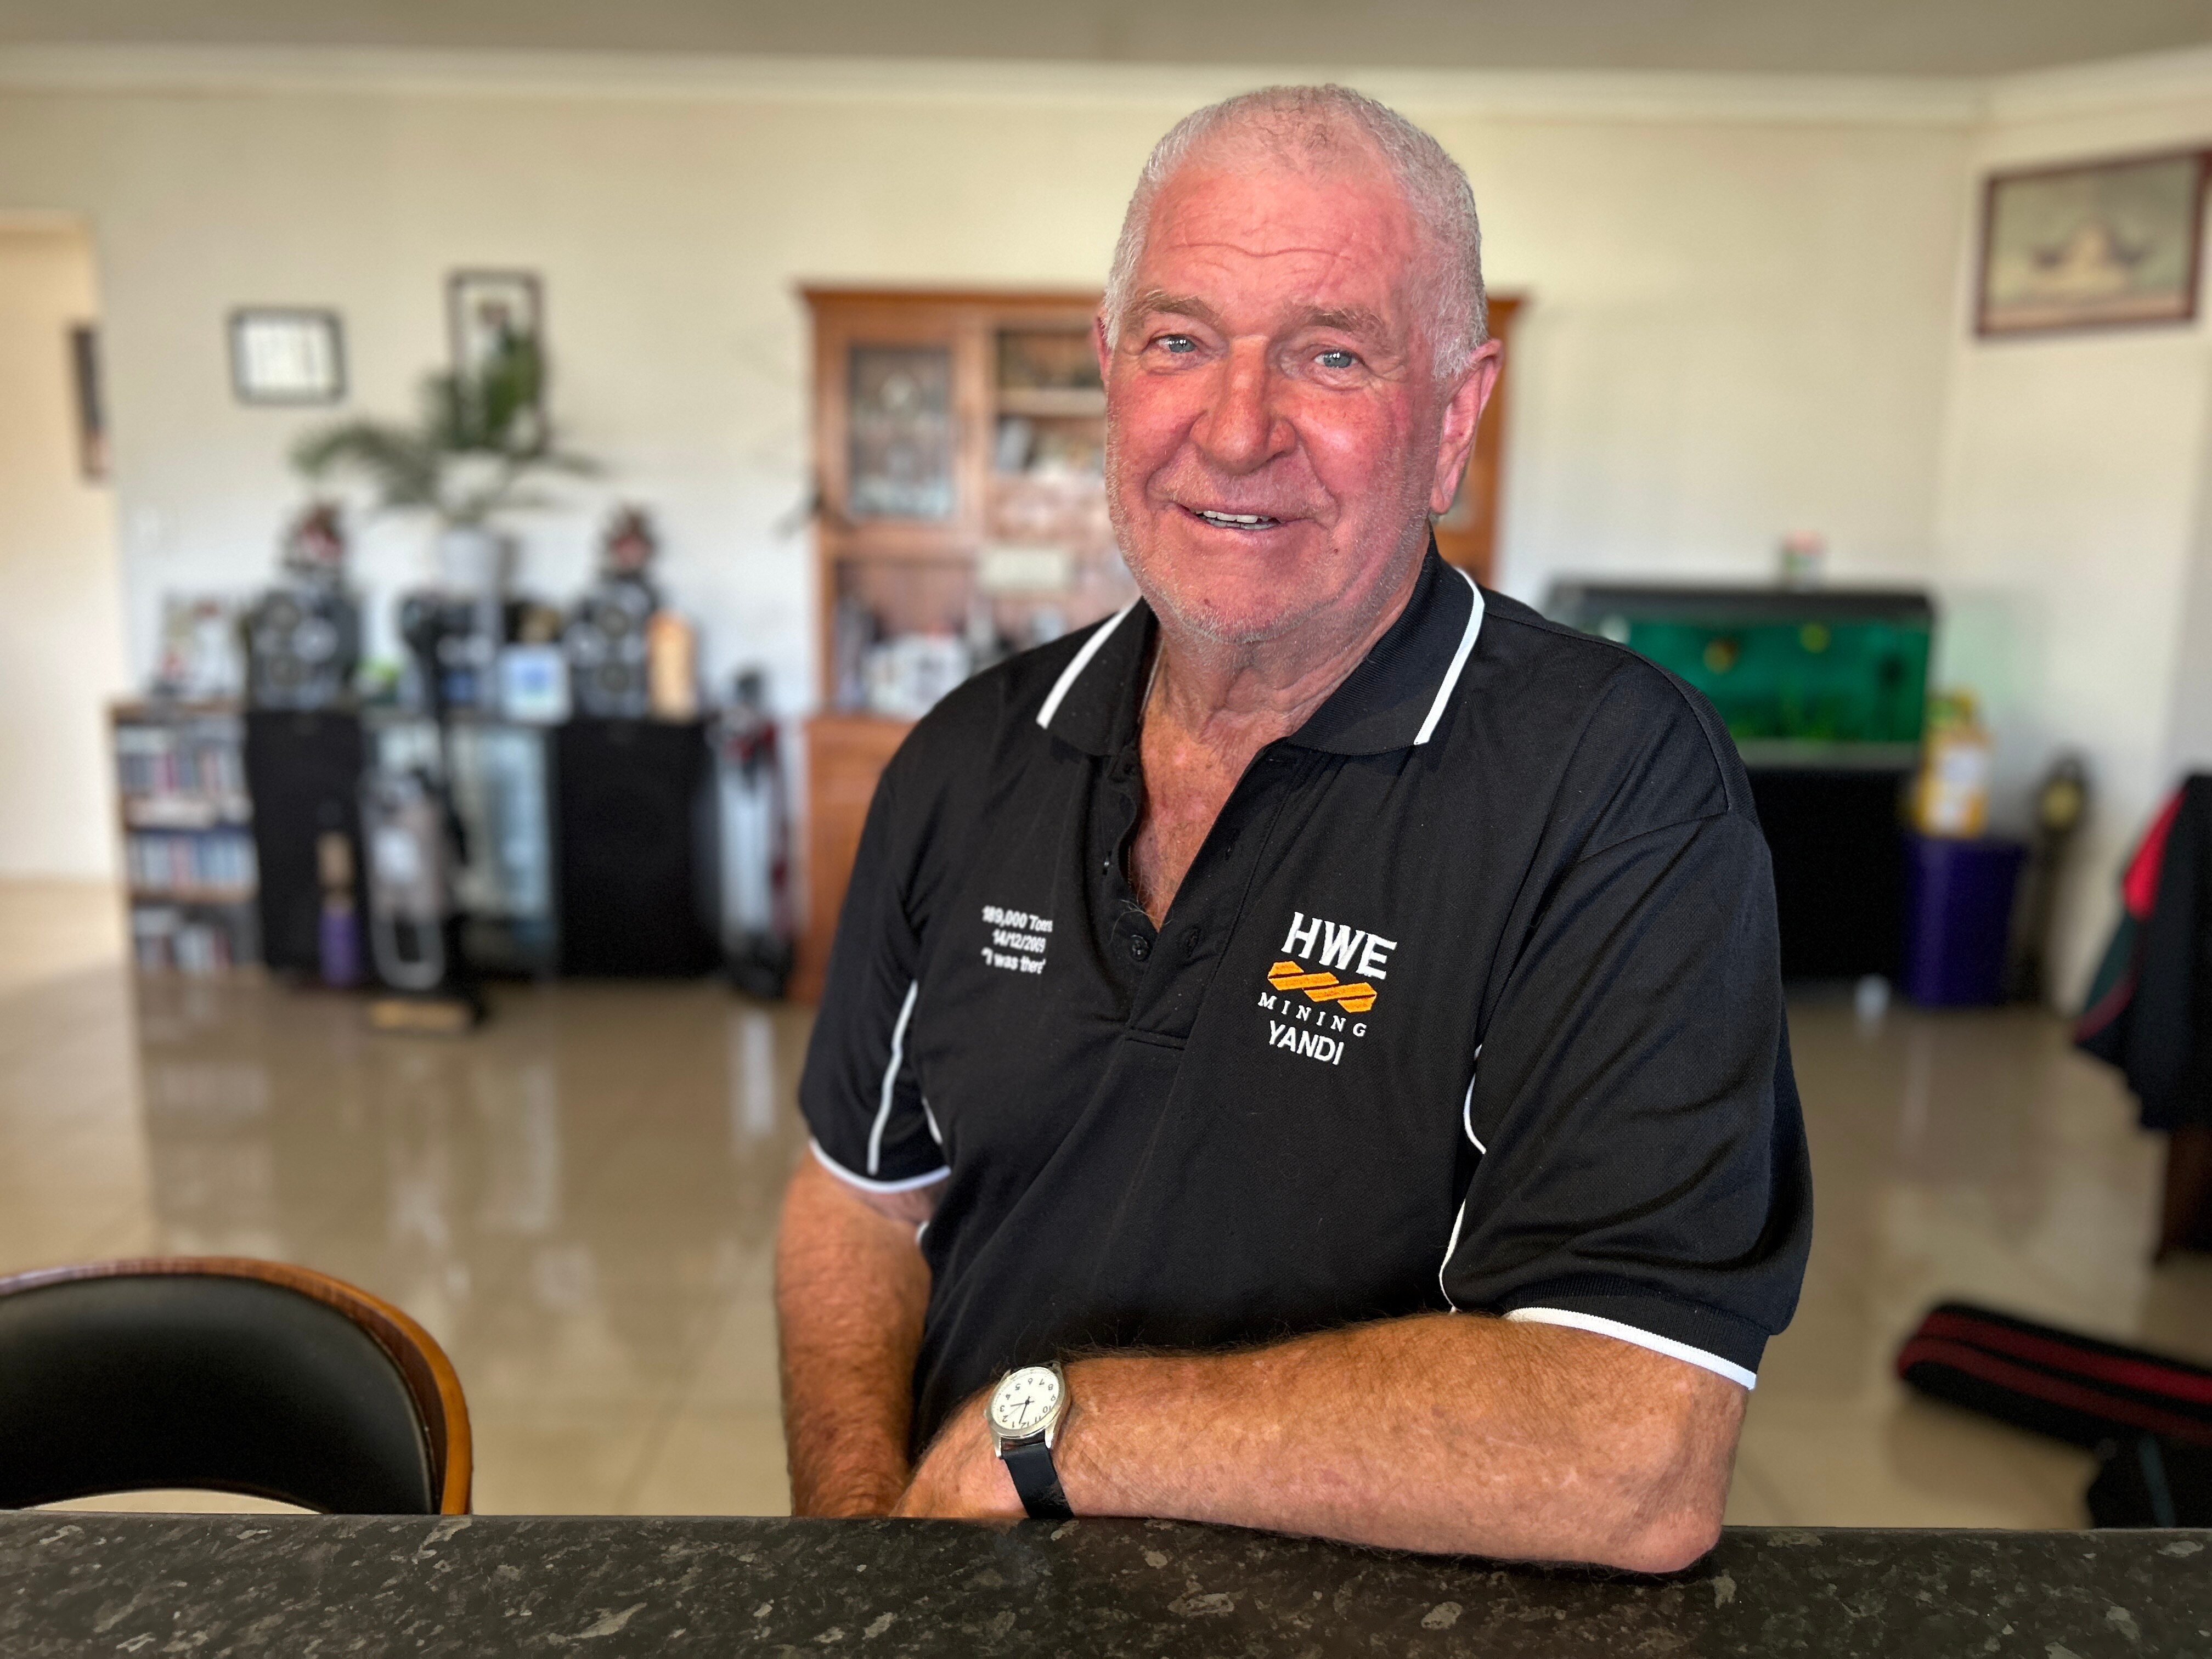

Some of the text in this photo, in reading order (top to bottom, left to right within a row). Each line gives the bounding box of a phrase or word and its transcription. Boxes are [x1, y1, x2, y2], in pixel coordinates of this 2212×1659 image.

[994, 953, 1018, 970] was
[1280, 911, 1397, 980] HWE
[1257, 992, 1367, 1037] MINING
[1269, 1020, 1344, 1065] YANDI
